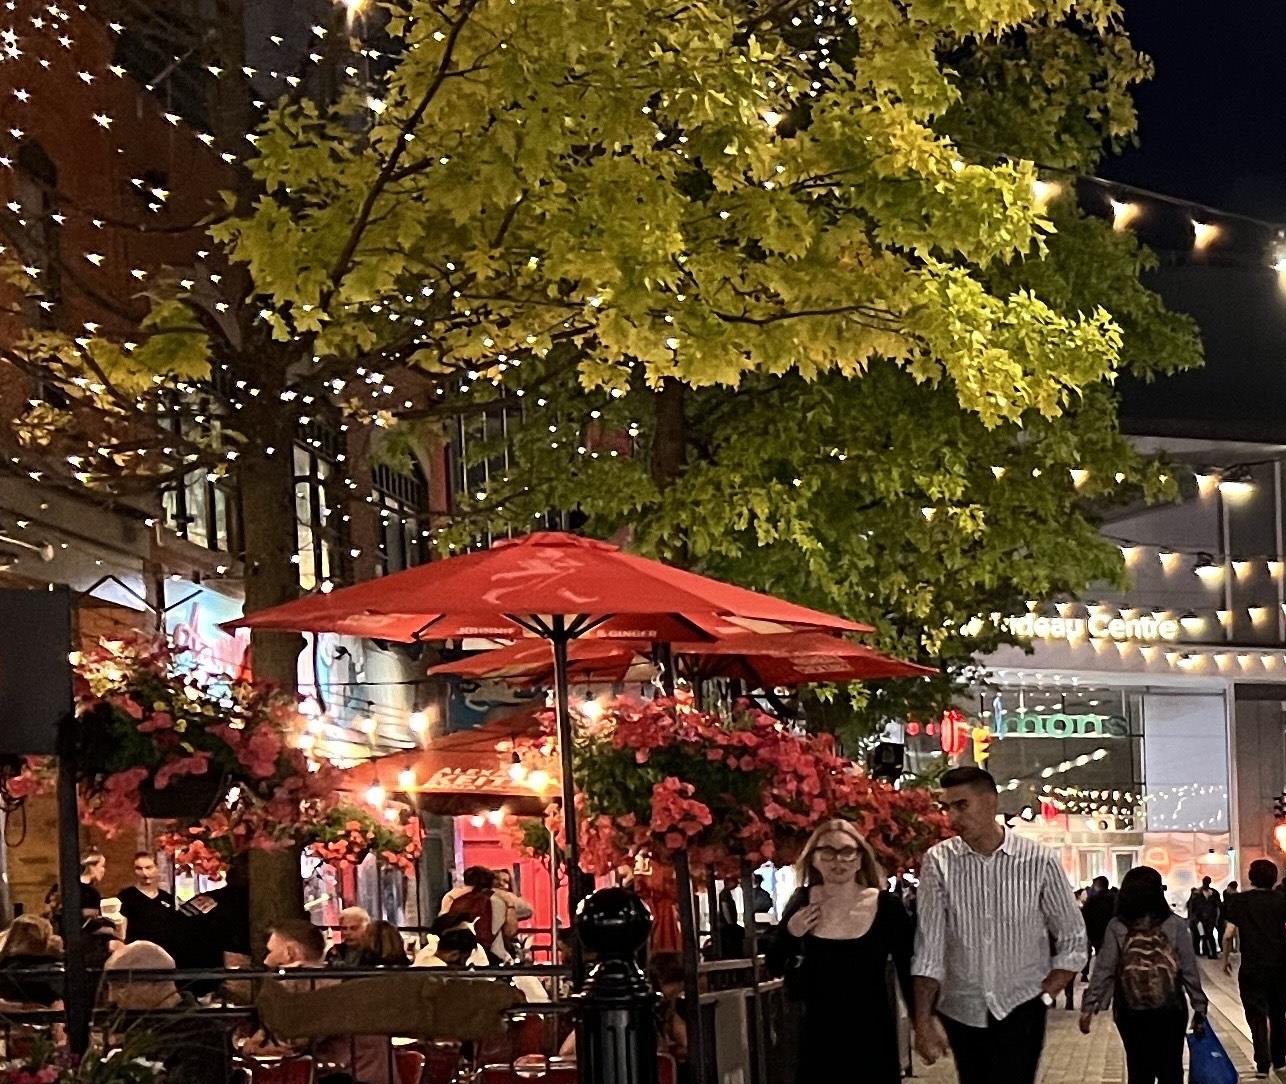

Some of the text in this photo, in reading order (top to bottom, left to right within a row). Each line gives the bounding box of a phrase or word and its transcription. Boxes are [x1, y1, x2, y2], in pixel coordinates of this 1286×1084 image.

[1008, 613, 1179, 641] ideau Centre
[993, 713, 1128, 738] mons
